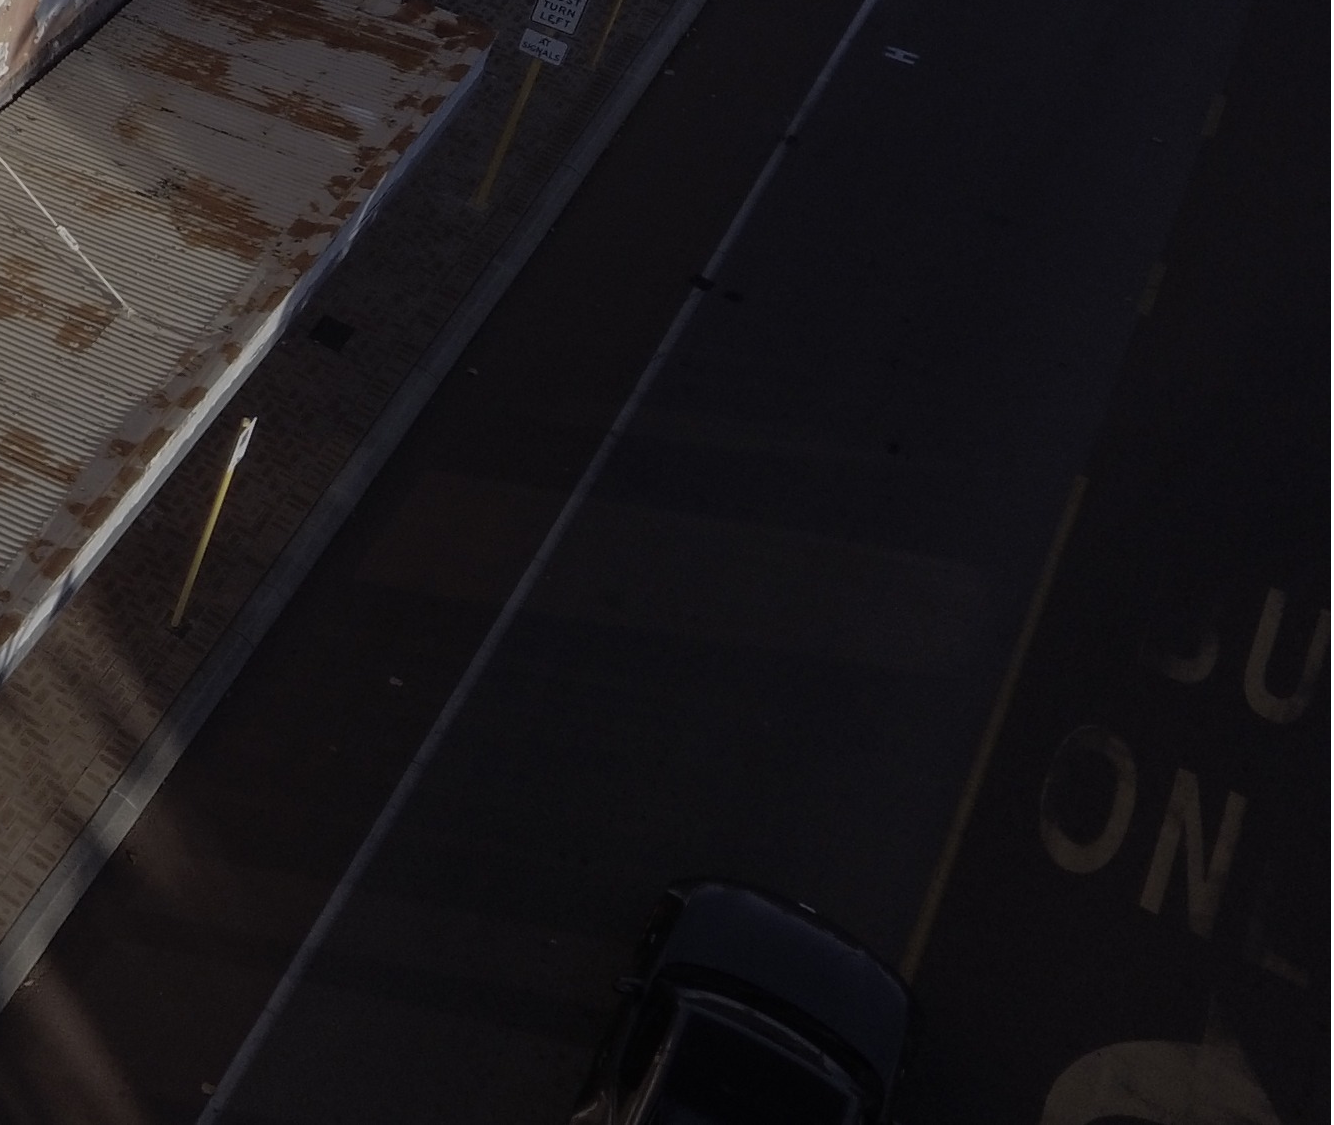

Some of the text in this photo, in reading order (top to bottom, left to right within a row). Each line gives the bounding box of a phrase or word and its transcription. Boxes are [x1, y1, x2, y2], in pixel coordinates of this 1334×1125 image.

[539, 11, 571, 28] LEFT
[539, 38, 551, 47] AT
[522, 41, 560, 62] SIGNALS
